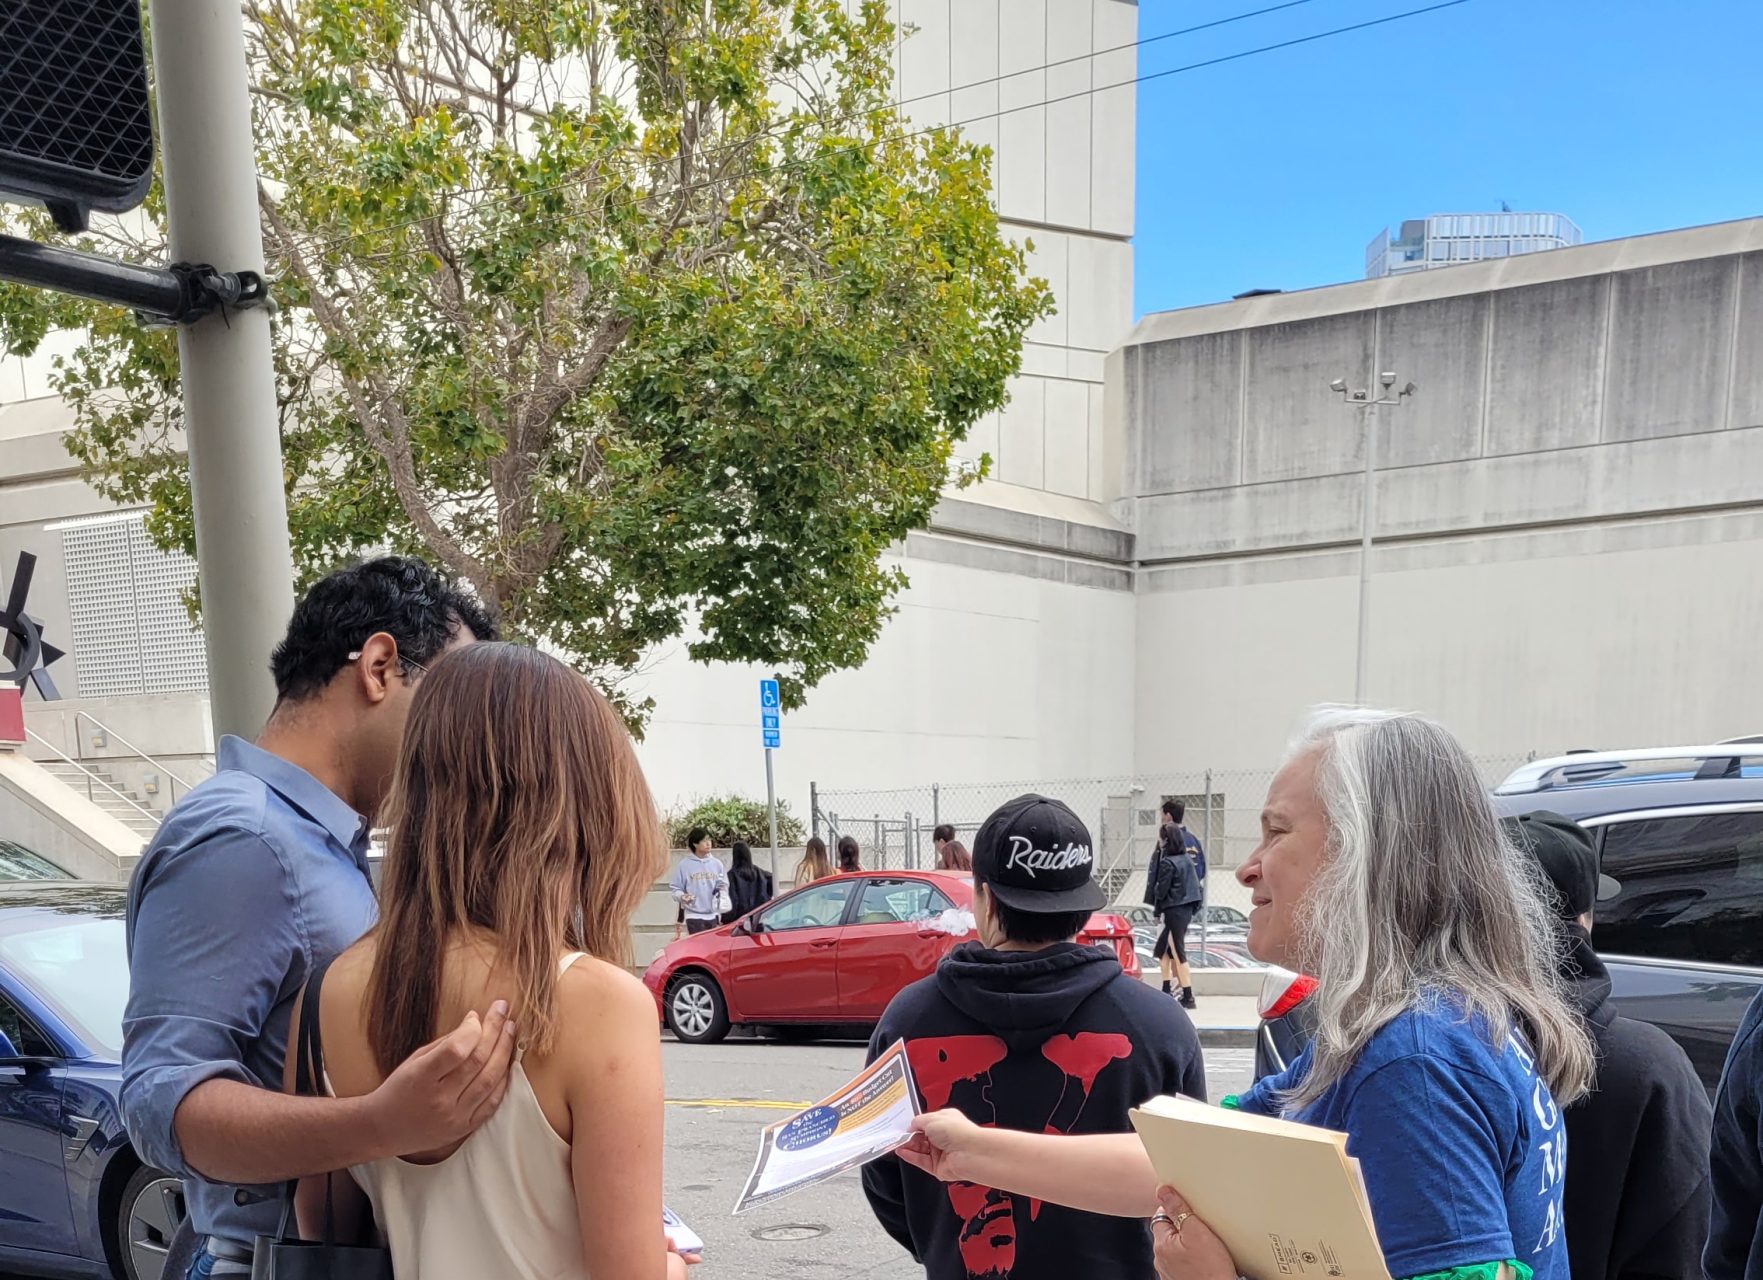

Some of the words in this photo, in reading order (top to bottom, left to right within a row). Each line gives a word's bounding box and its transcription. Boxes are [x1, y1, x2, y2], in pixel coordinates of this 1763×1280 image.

[1006, 836, 1092, 878] Raiders
[791, 1108, 823, 1130] SAVE
[783, 1128, 832, 1151] CHORUS!
